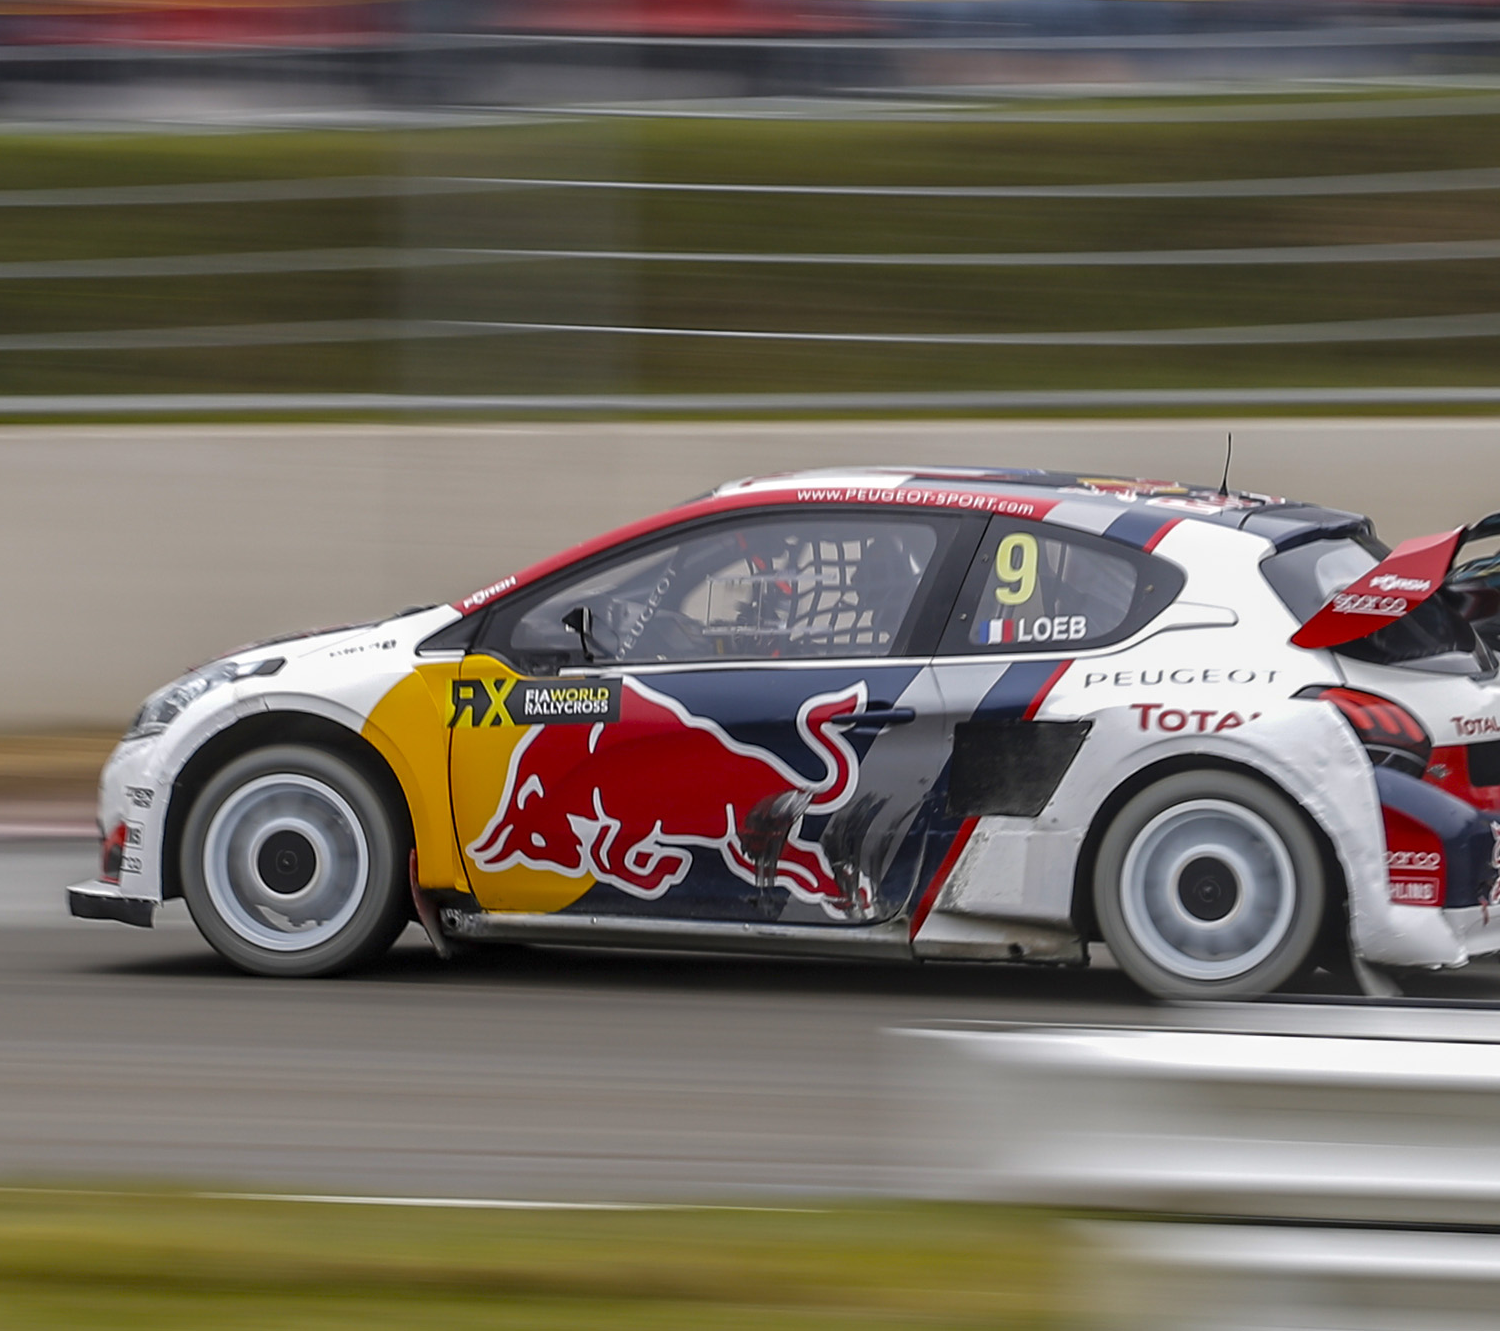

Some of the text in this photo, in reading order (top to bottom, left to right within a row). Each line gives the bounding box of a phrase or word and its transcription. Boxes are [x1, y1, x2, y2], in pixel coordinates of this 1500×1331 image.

[797, 487, 1034, 517] www.PEUGEOT-SPORT.com
[996, 532, 1038, 605] 9
[1017, 615, 1087, 643] LOEB
[1084, 668, 1282, 689] PEUGEOT
[446, 667, 518, 728] RX
[525, 700, 609, 715] RALLYCROSS
